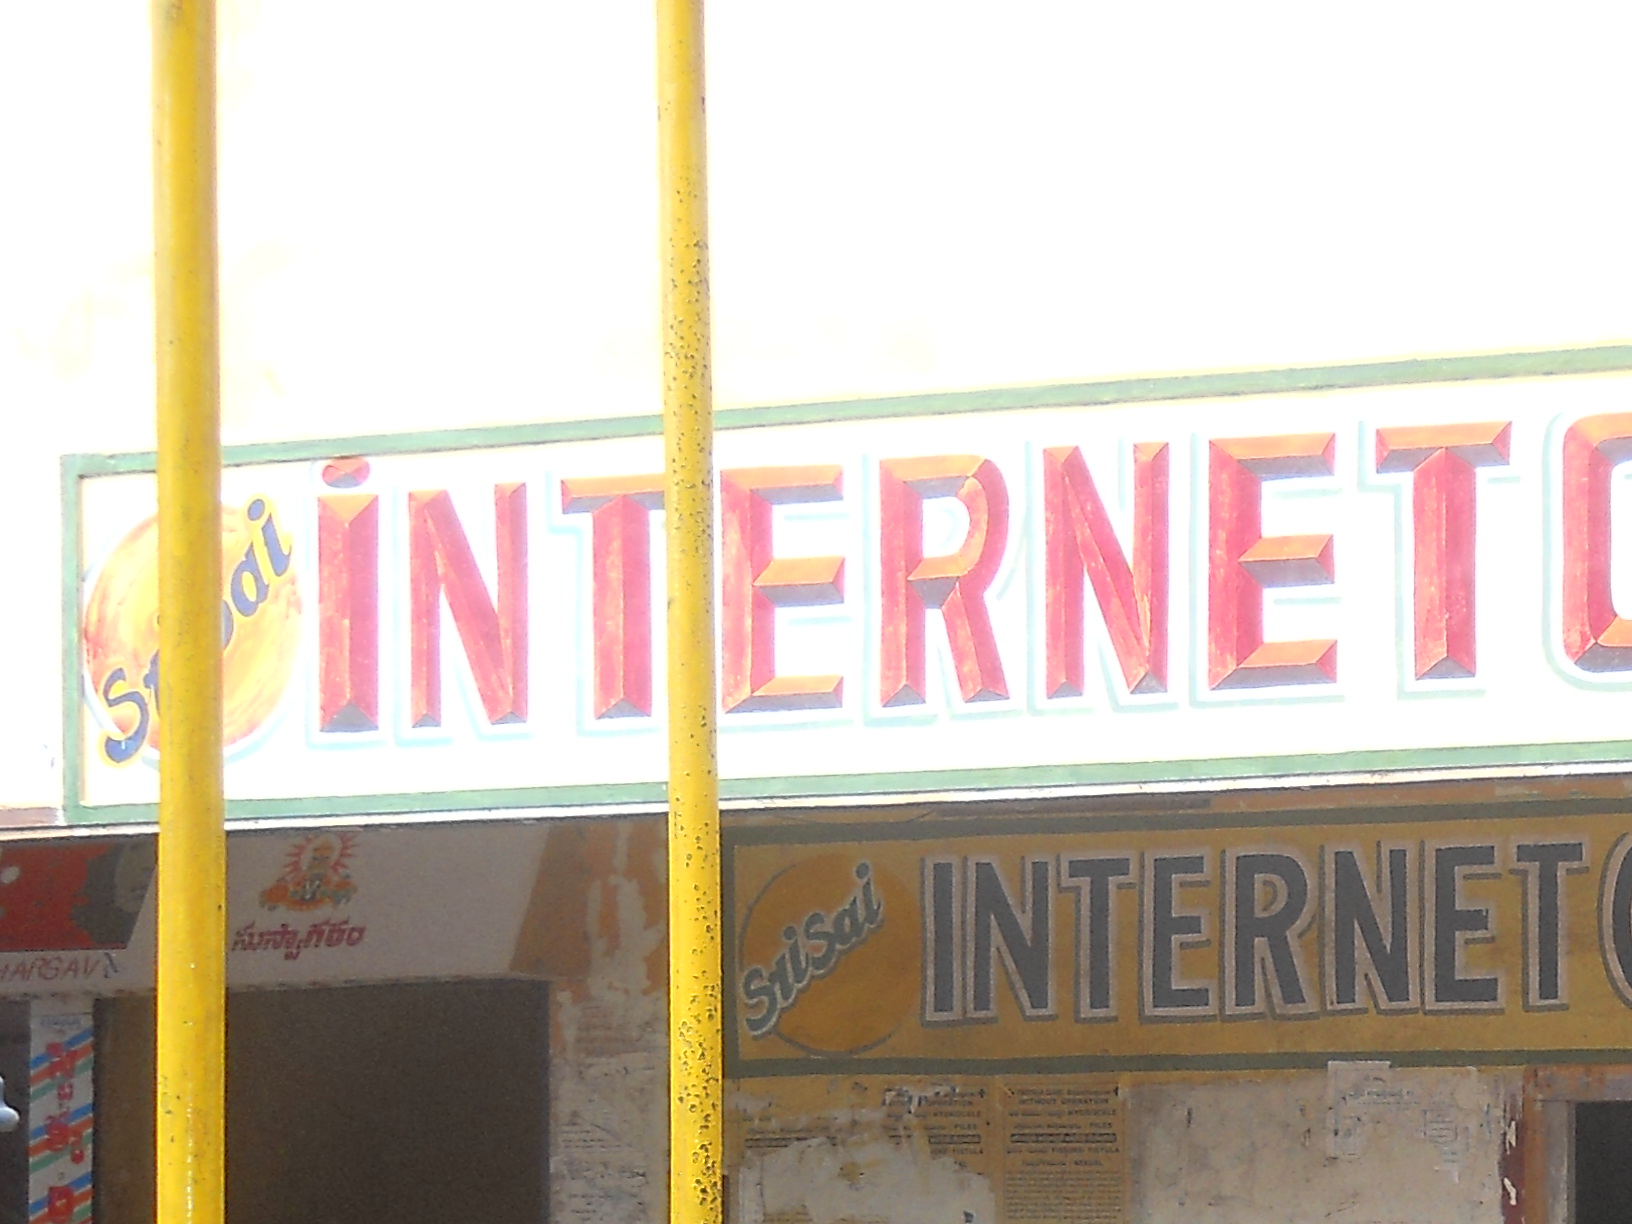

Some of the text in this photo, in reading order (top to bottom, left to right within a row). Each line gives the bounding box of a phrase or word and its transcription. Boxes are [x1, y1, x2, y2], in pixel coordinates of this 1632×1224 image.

[103, 498, 293, 764] Sai
[740, 861, 888, 1041] SriSai
[922, 838, 1588, 1023] INTERNET
